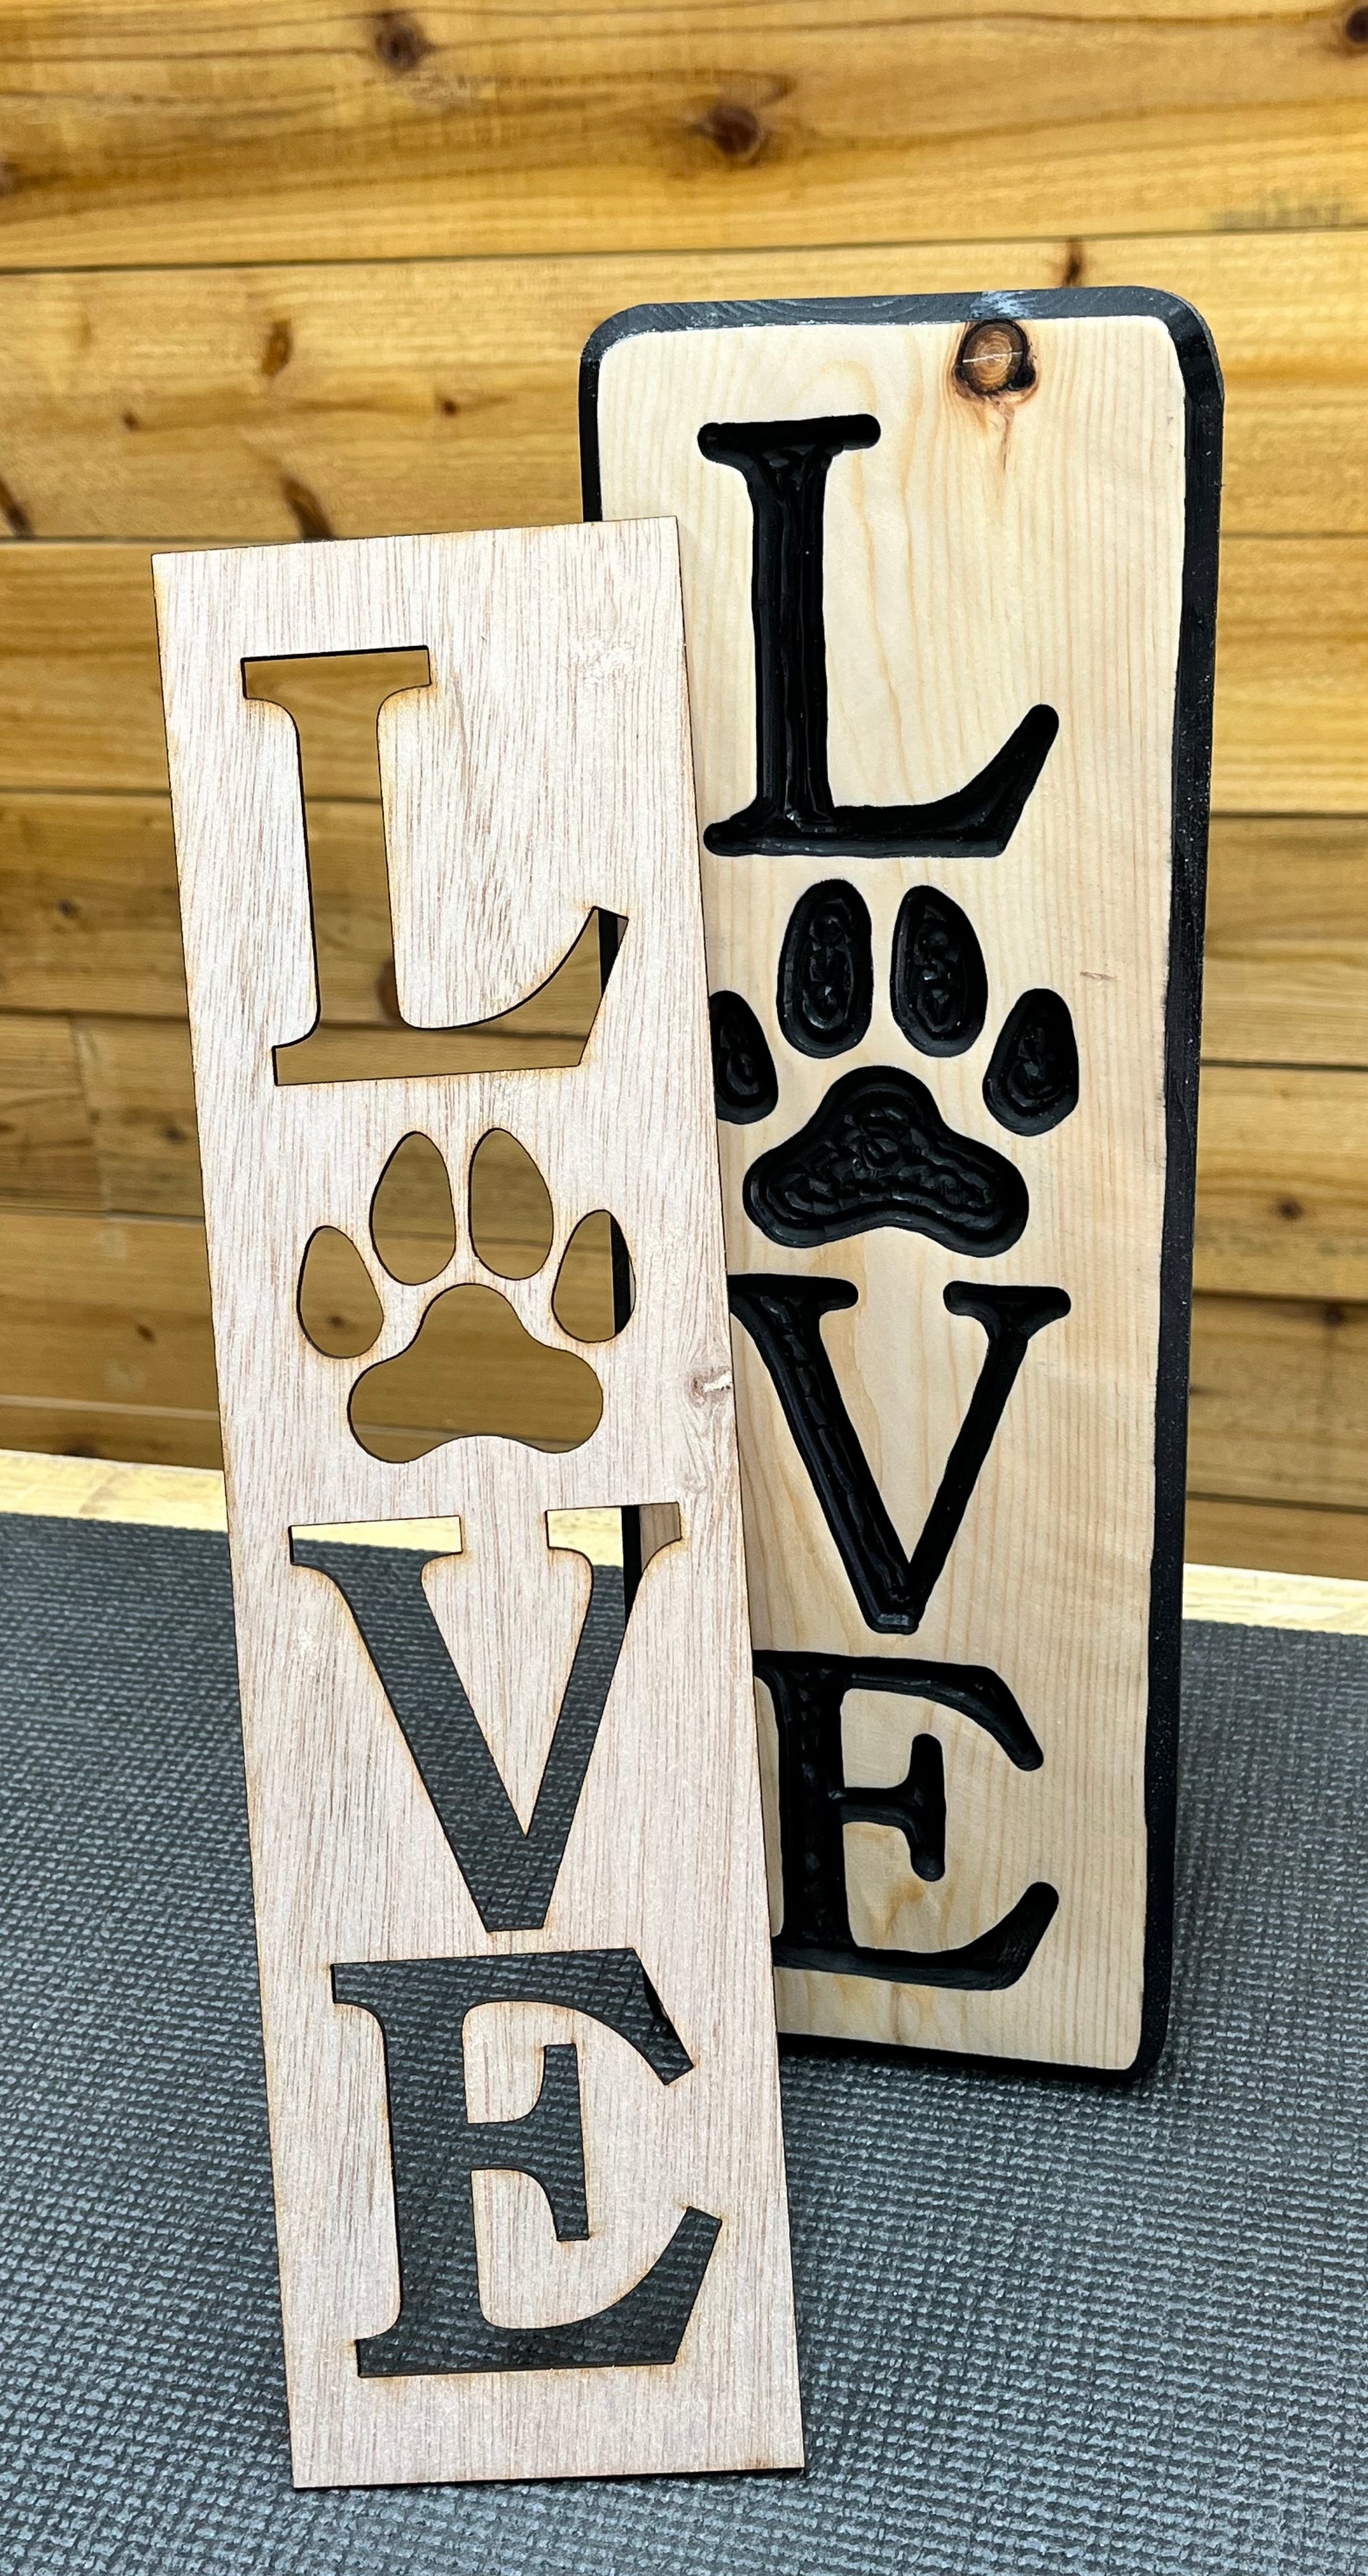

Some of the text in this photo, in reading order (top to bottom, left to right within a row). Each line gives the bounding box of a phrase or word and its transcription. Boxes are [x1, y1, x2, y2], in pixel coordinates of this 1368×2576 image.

[697, 414, 1059, 858] L
[240, 645, 723, 2378] L V E
